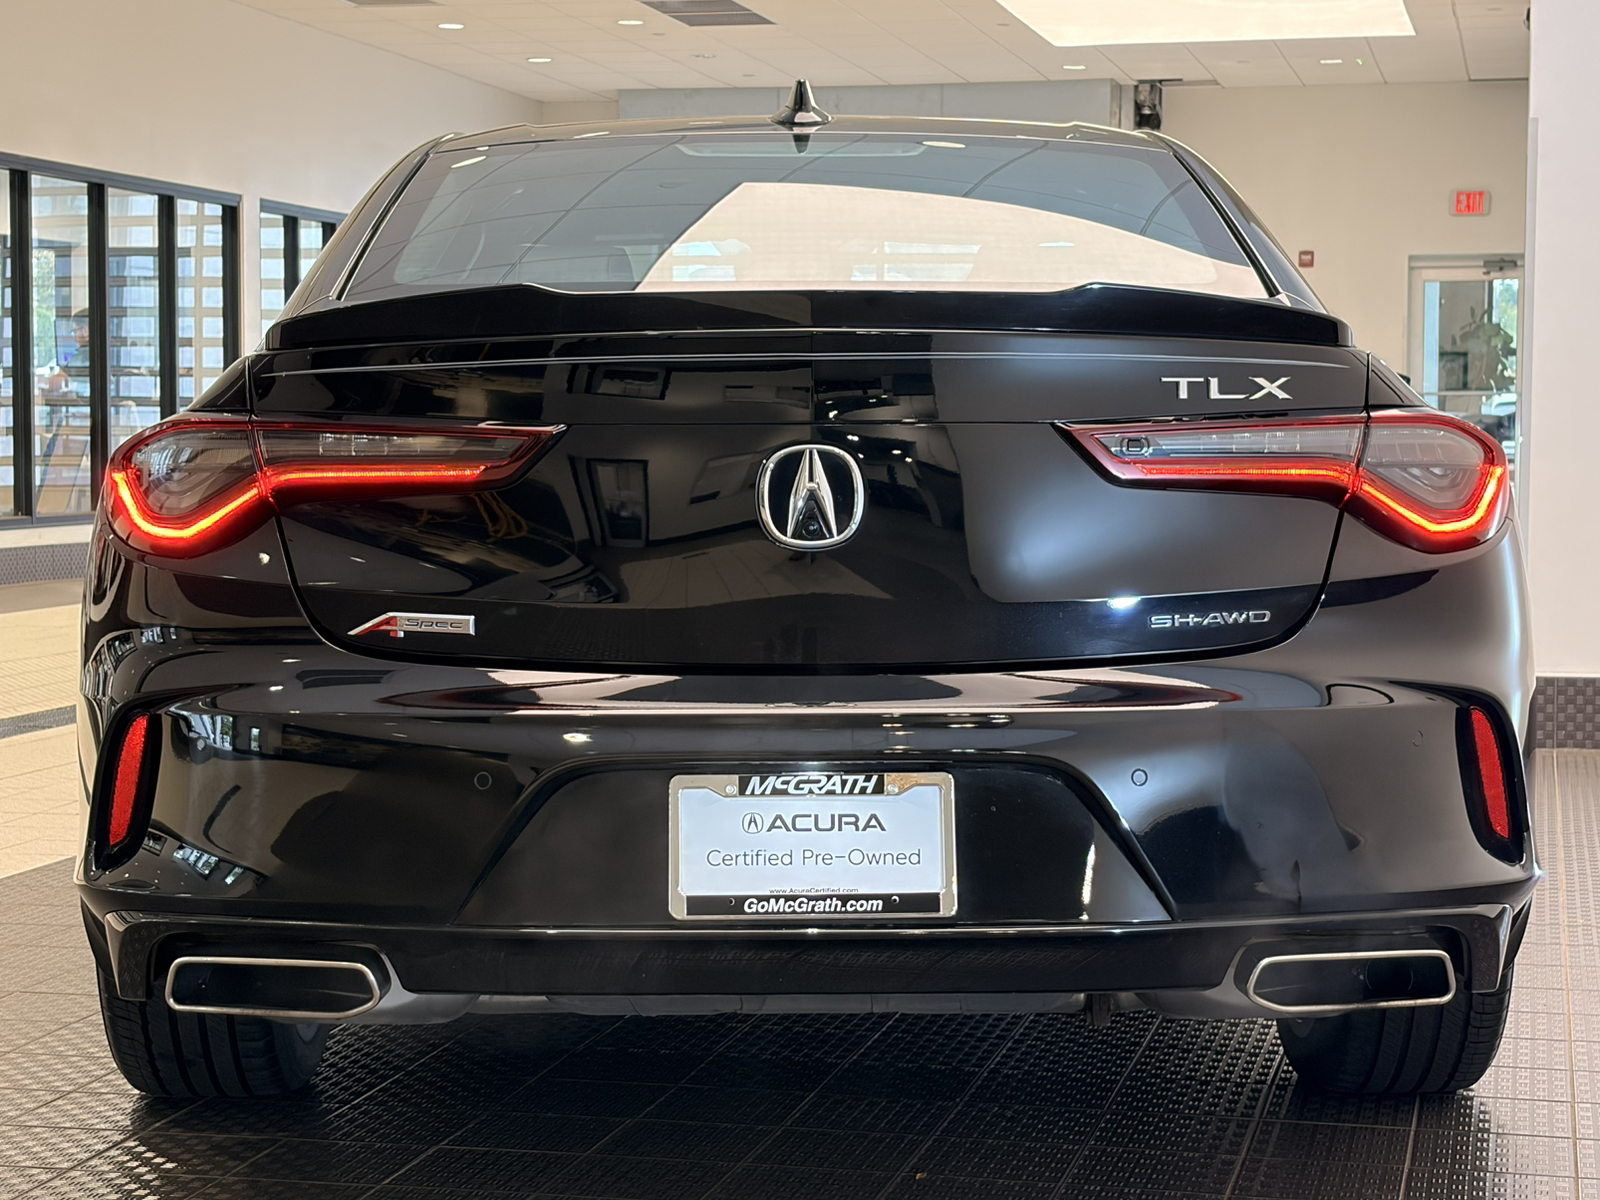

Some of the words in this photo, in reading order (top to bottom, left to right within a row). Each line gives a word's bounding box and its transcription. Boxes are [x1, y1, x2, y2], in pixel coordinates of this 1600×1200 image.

[1456, 191, 1485, 214] EXIT
[1160, 376, 1293, 400] TLX
[1149, 610, 1271, 628] SH-AWD
[766, 813, 887, 832] ACURA
[706, 849, 793, 867] Certified
[802, 848, 921, 866] Pre-Owned
[744, 897, 883, 913] GoMcGrath.com
